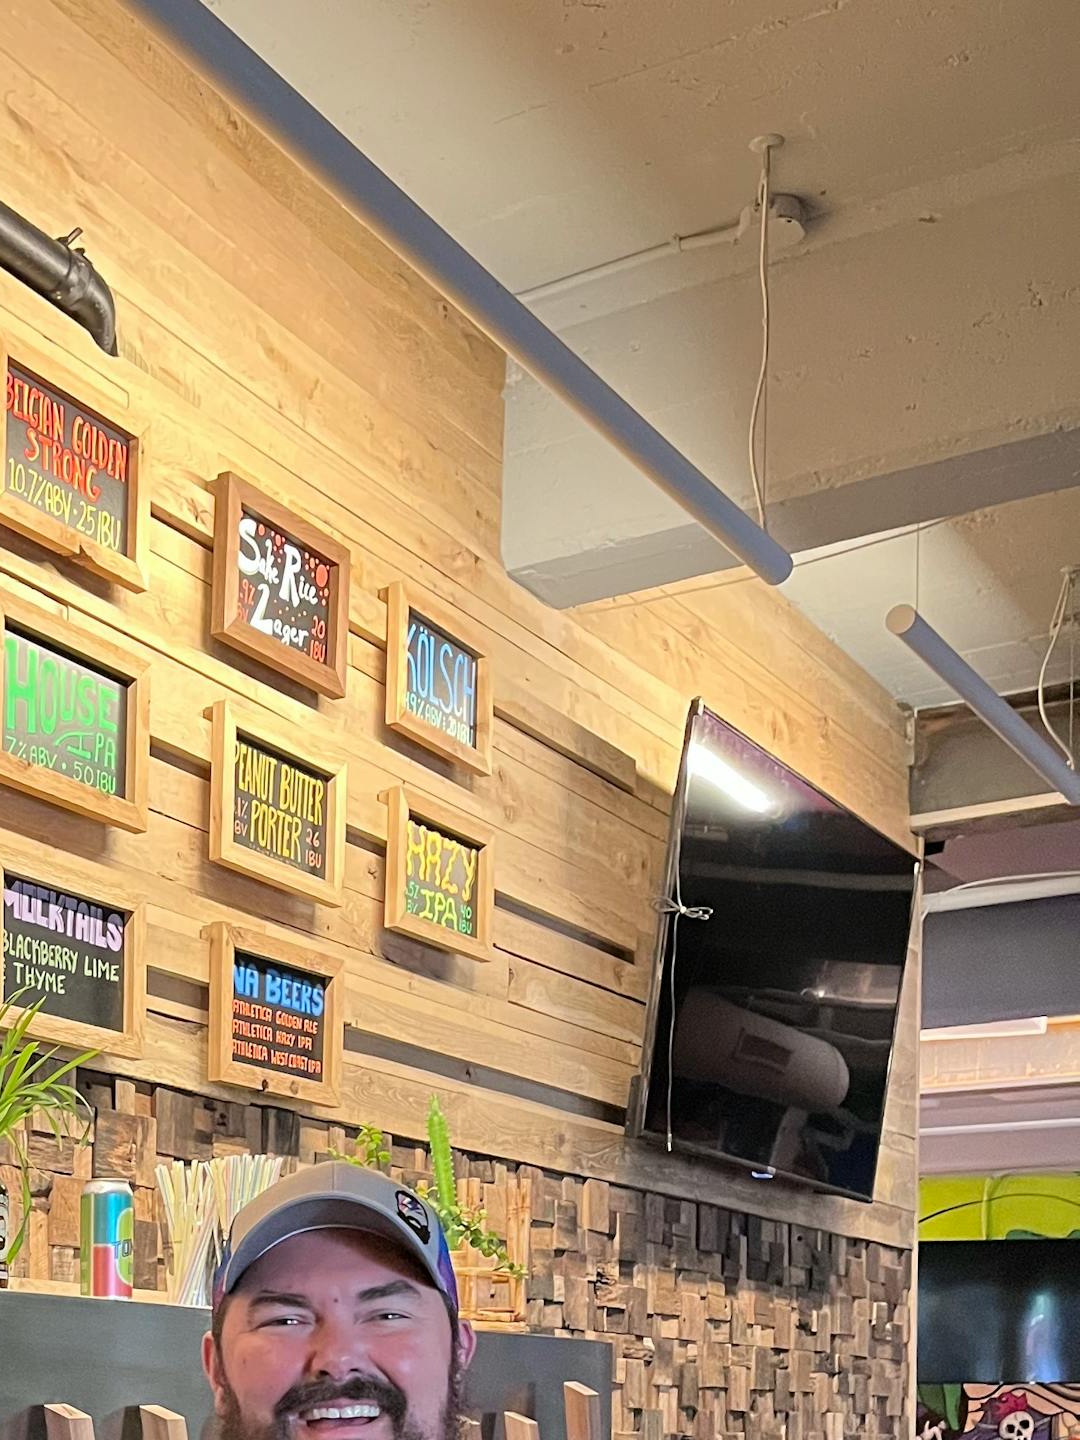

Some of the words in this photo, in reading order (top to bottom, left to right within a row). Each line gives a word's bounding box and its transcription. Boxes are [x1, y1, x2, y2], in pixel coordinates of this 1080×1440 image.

[24, 426, 103, 504] STRONG
[72, 415, 127, 483] GOLDEN
[76, 500, 96, 536] 25
[96, 510, 121, 551] IBU
[238, 518, 279, 585] Sake
[279, 543, 319, 608] Rice
[249, 583, 310, 647] Lager
[312, 615, 325, 639] 20
[310, 639, 325, 663] IBU
[406, 623, 476, 726] KÖLSCH
[4, 637, 119, 735] HOUSE
[5, 735, 27, 760] 7%
[29, 744, 58, 769] ABV
[72, 761, 95, 787] 50
[96, 769, 116, 795] IBU
[55, 731, 116, 770] IPA
[235, 741, 277, 804] PEANUT
[280, 763, 324, 826] BUTTER
[250, 800, 302, 863] PORTER
[305, 827, 320, 847] 26
[305, 850, 322, 869] IBU
[407, 820, 477, 902] HAZY
[3, 880, 124, 953] MOCKTAILS
[419, 888, 457, 931] IPA
[2, 928, 78, 974] BLACKBERRY
[84, 955, 120, 982] LIME
[13, 962, 66, 995] THYME
[234, 961, 259, 998] NA
[265, 968, 324, 1017] BEERS
[275, 1010, 303, 1030] GOLDEN
[303, 1019, 318, 1035] ALE
[297, 1035, 312, 1051] IPA
